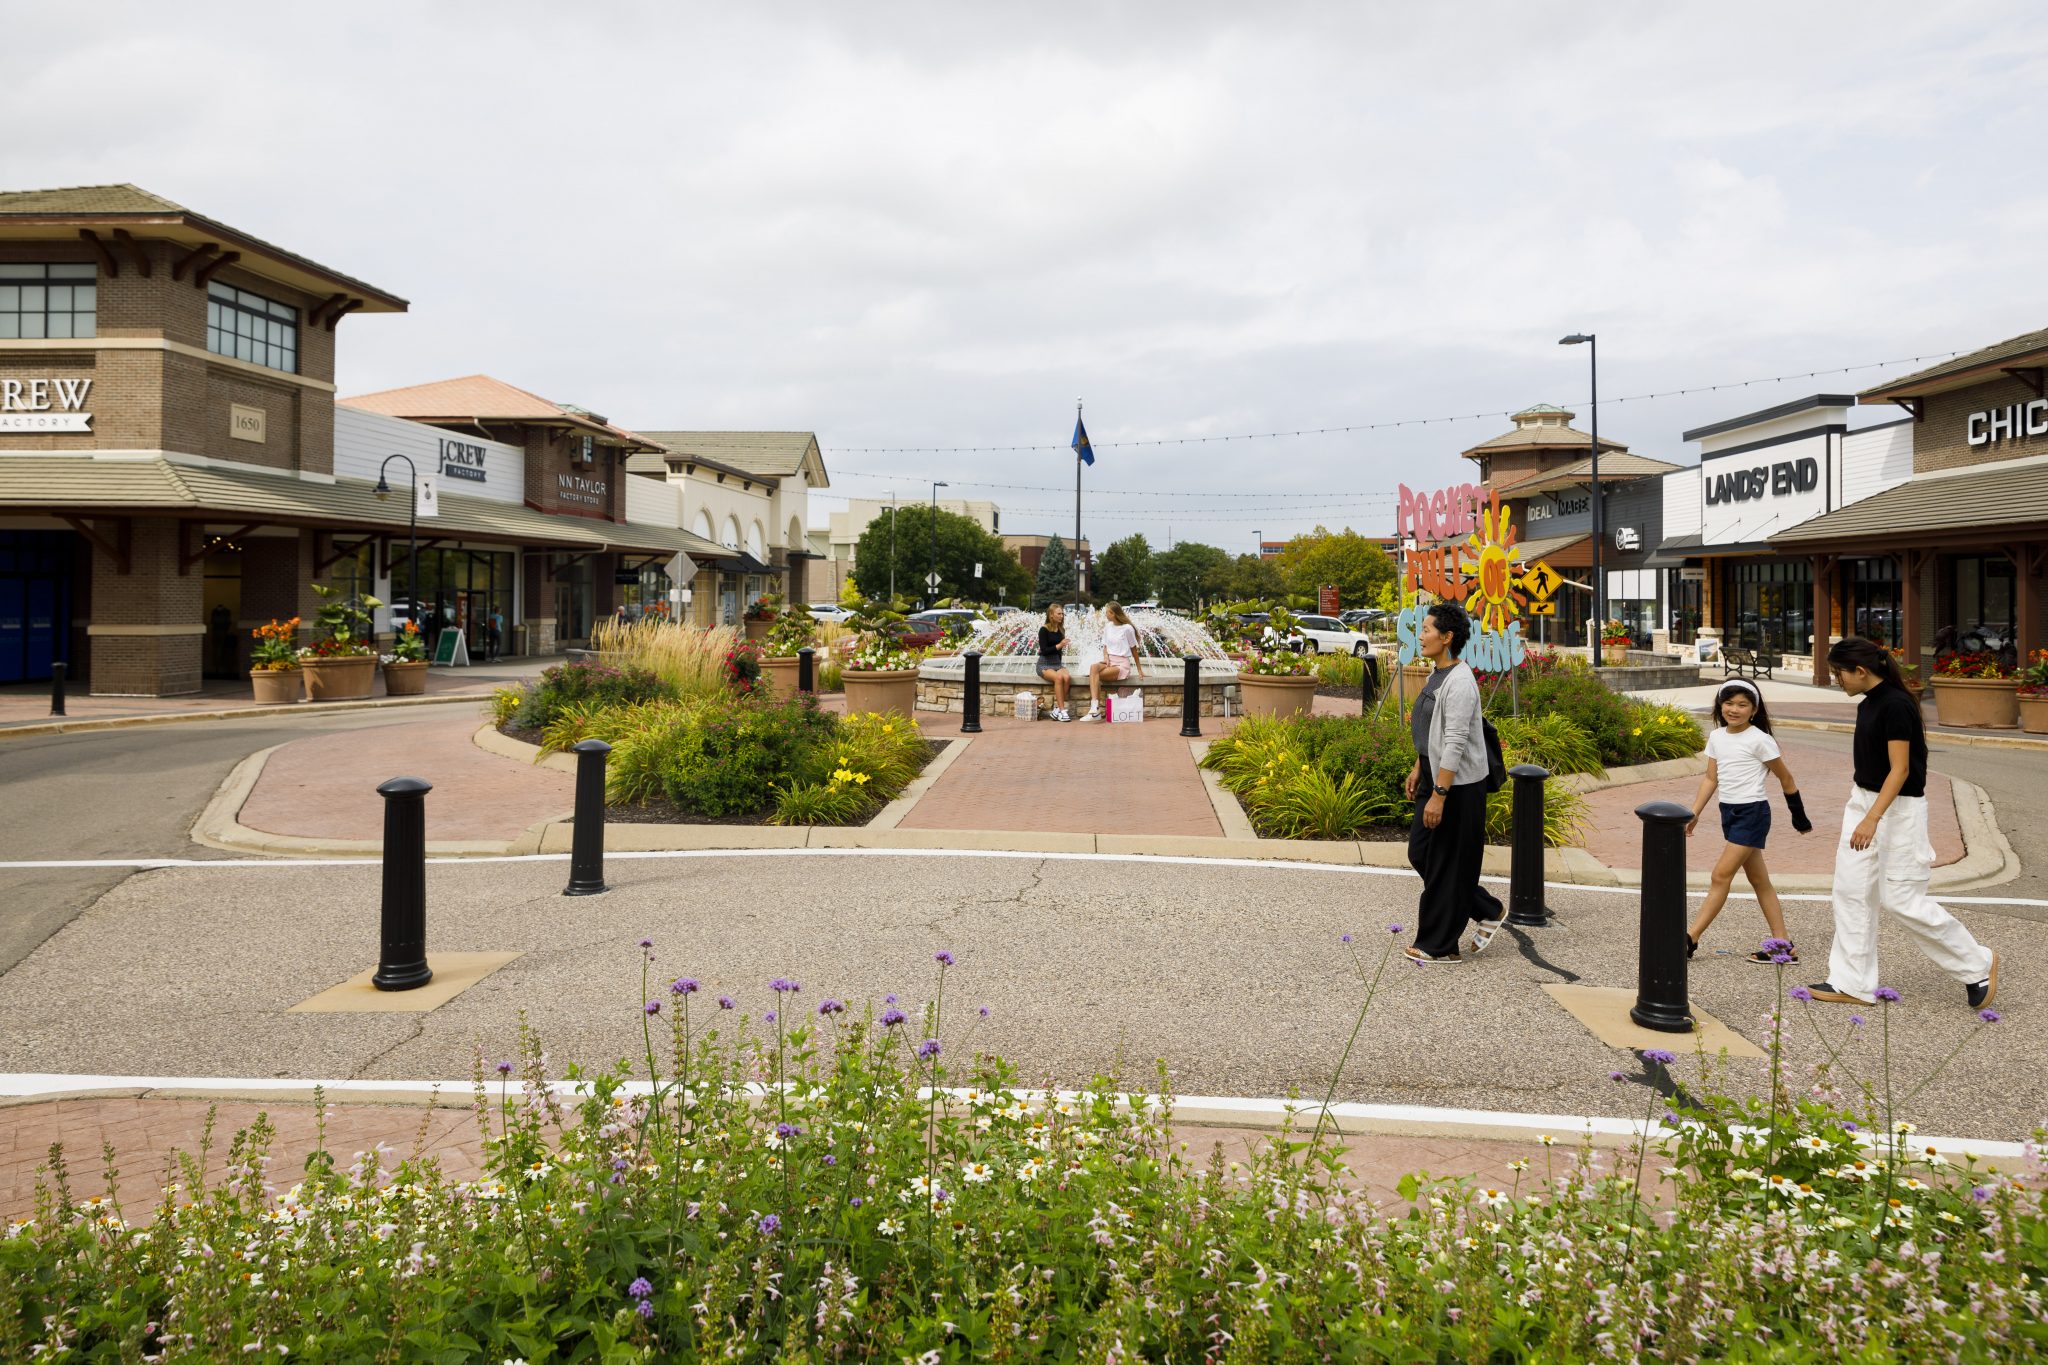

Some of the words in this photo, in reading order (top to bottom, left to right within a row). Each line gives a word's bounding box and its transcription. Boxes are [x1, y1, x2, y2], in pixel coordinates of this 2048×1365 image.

[236, 415, 260, 432] 1650
[1967, 398, 2048, 446] CHIC
[437, 438, 487, 474] J.CREW
[574, 476, 607, 496] TAYLOR
[1705, 465, 1769, 506] LANDS'
[1771, 456, 1819, 496] END
[1398, 482, 1488, 543] POCKET
[1527, 505, 1553, 522] IDEAL
[1406, 544, 1468, 601] FULL
[1483, 558, 1508, 598] OF
[1113, 711, 1142, 722] LOFT
